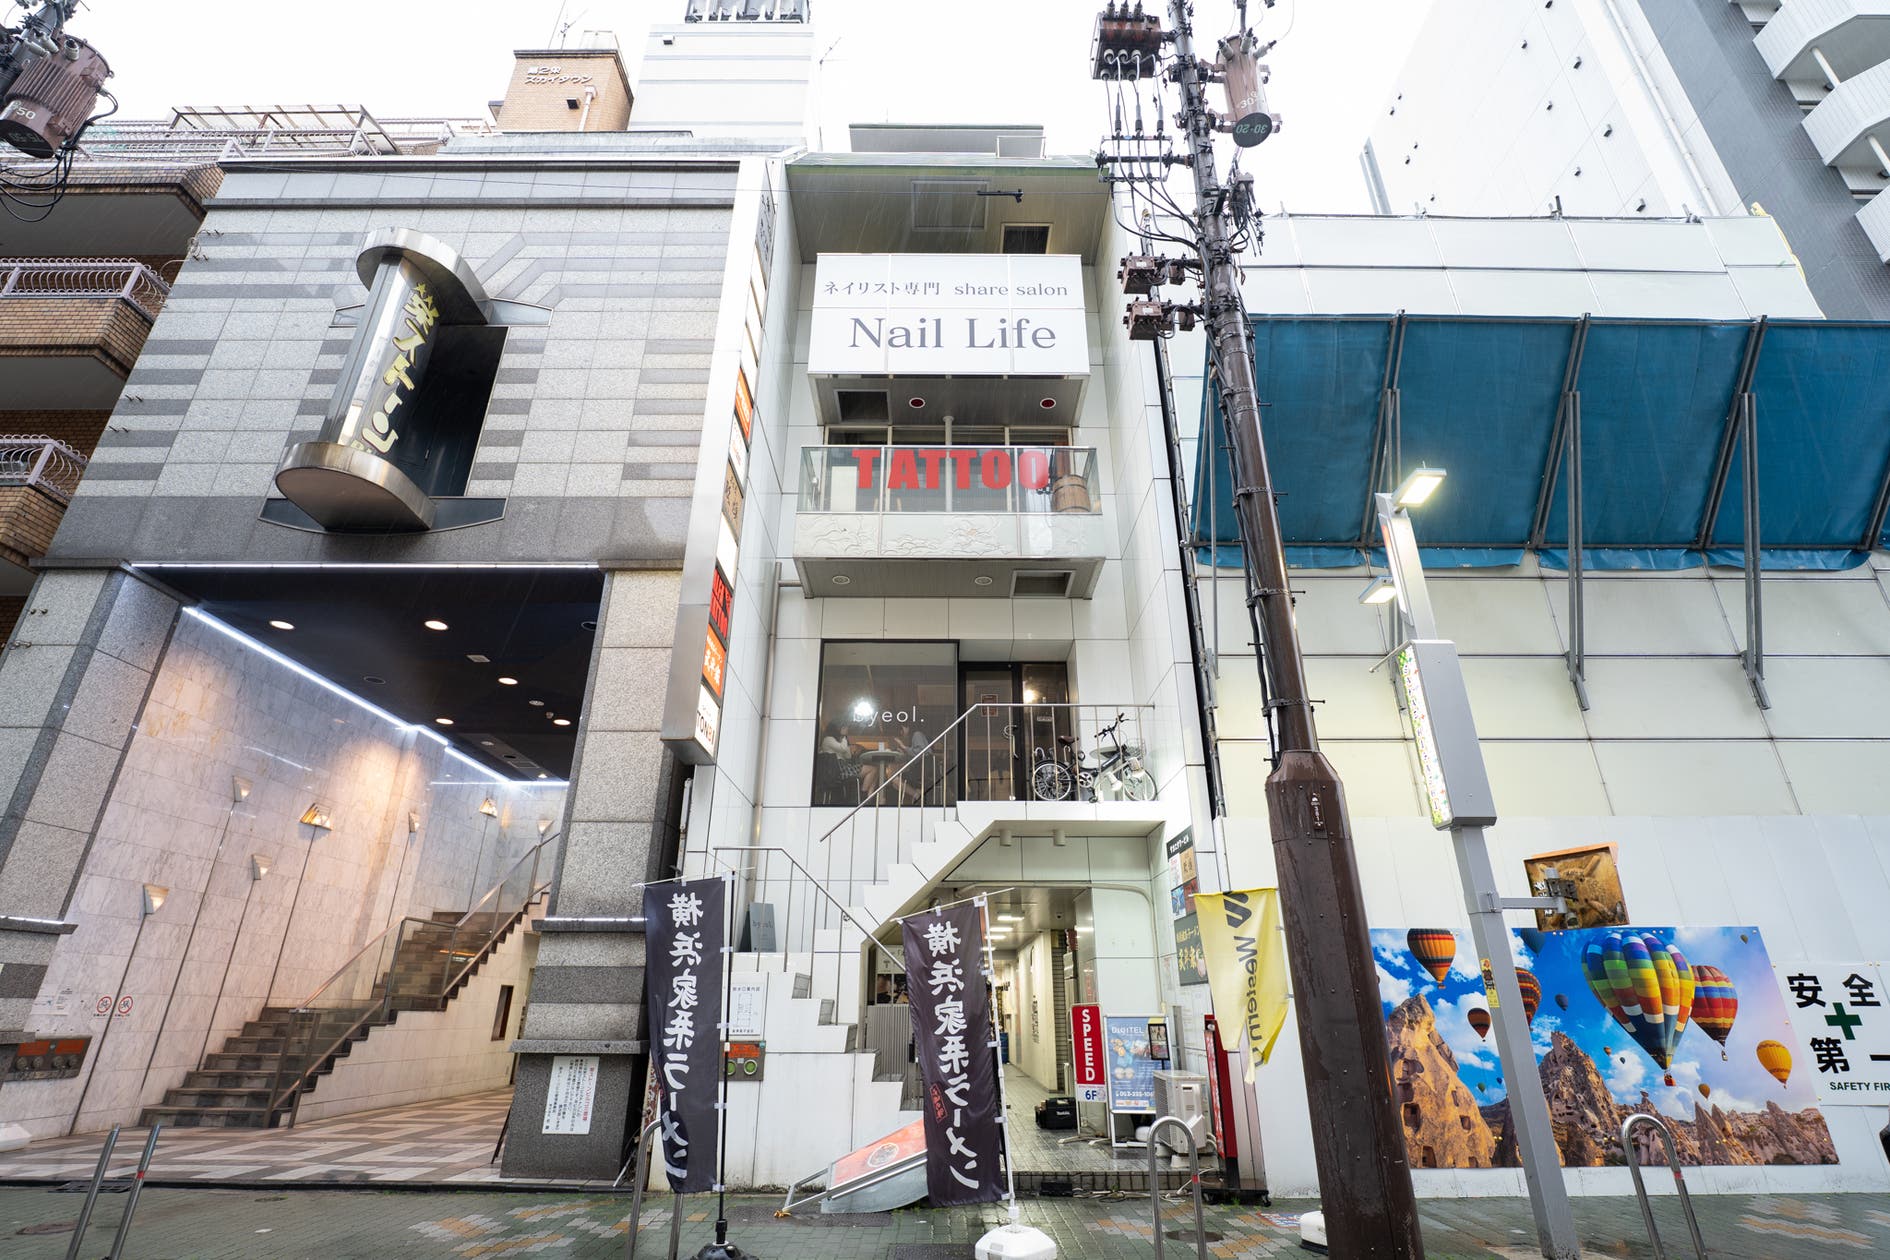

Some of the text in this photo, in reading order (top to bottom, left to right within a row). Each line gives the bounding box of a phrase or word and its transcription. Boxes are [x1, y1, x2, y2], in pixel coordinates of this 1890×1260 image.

[824, 281, 1068, 297] ネイリスト専門 share salon
[847, 317, 1057, 349] Nail Life
[851, 449, 1050, 490] TATTOO
[1786, 972, 1881, 1008] 安全
[1081, 1008, 1096, 1082] SPEED
[1085, 1090, 1097, 1101] 6F
[1829, 1081, 1870, 1091] SAFETY
